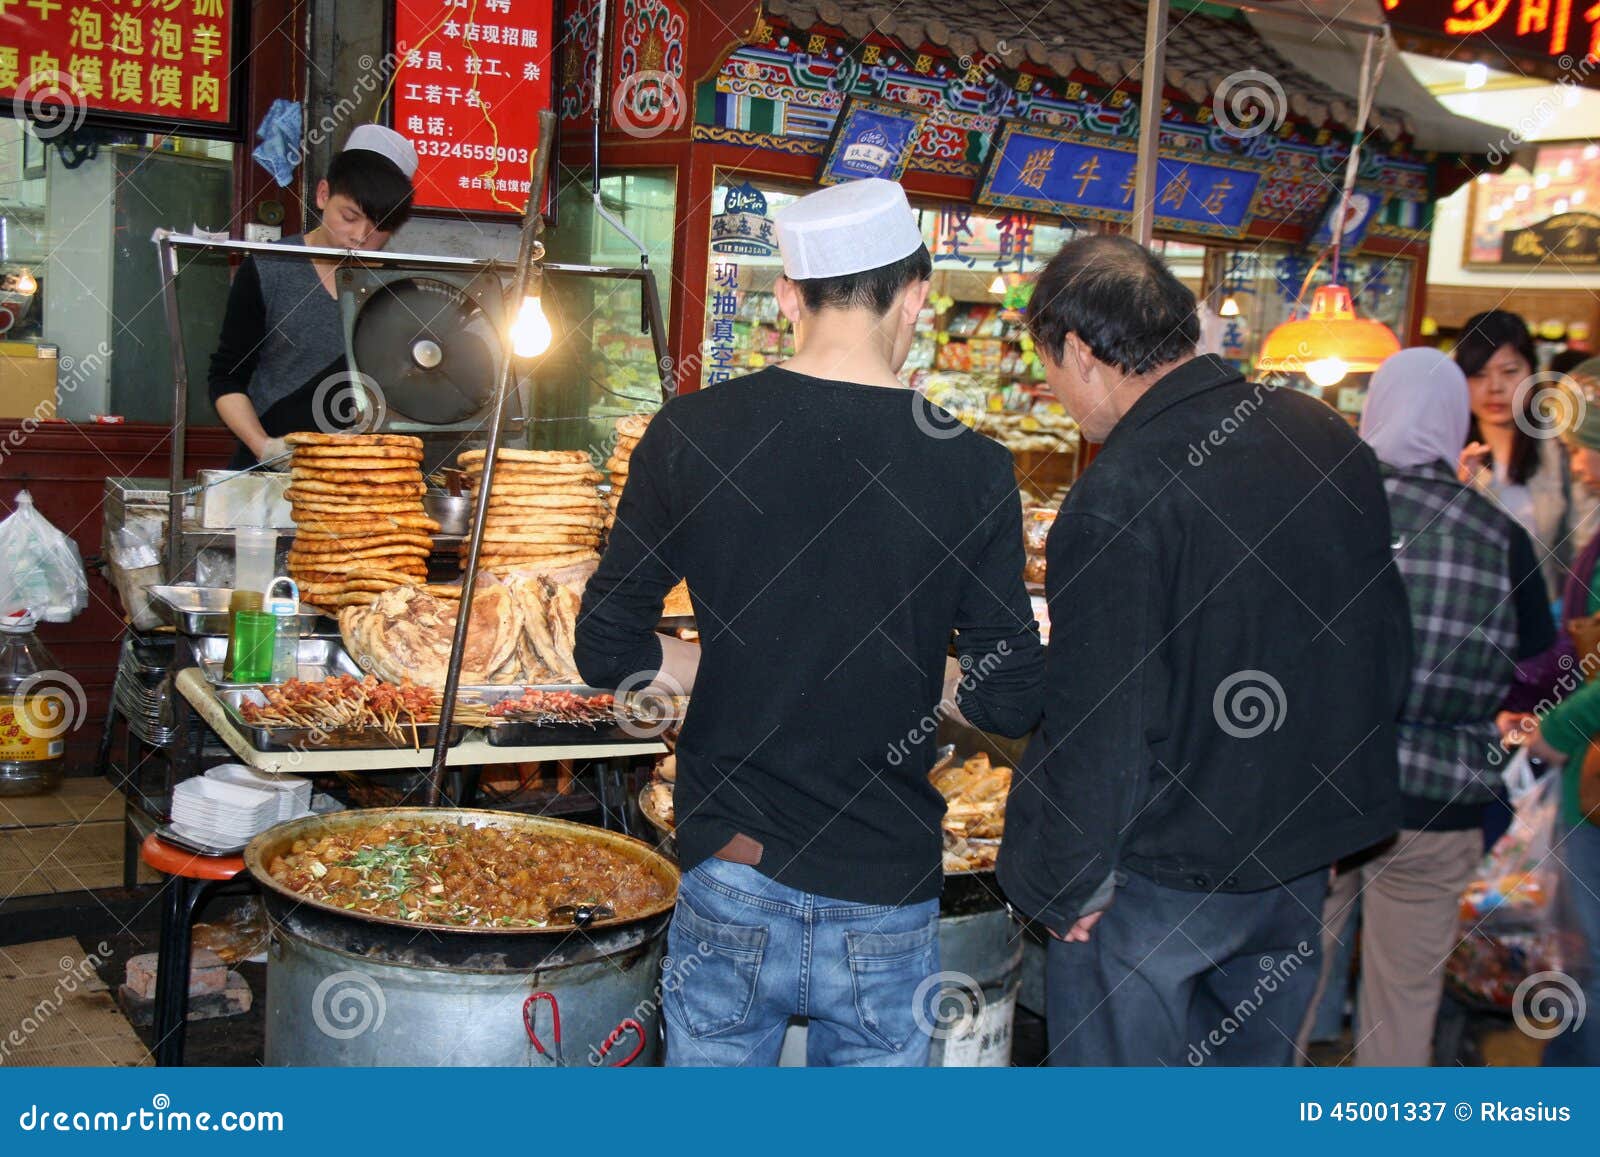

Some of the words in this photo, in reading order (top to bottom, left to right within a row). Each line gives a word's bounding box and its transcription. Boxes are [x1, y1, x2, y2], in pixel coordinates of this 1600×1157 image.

[68, 0, 104, 100] 泡馍
[109, 0, 144, 104] 泡馍
[149, 0, 184, 109] 泡馍
[443, 19, 538, 48] 本店现招服
